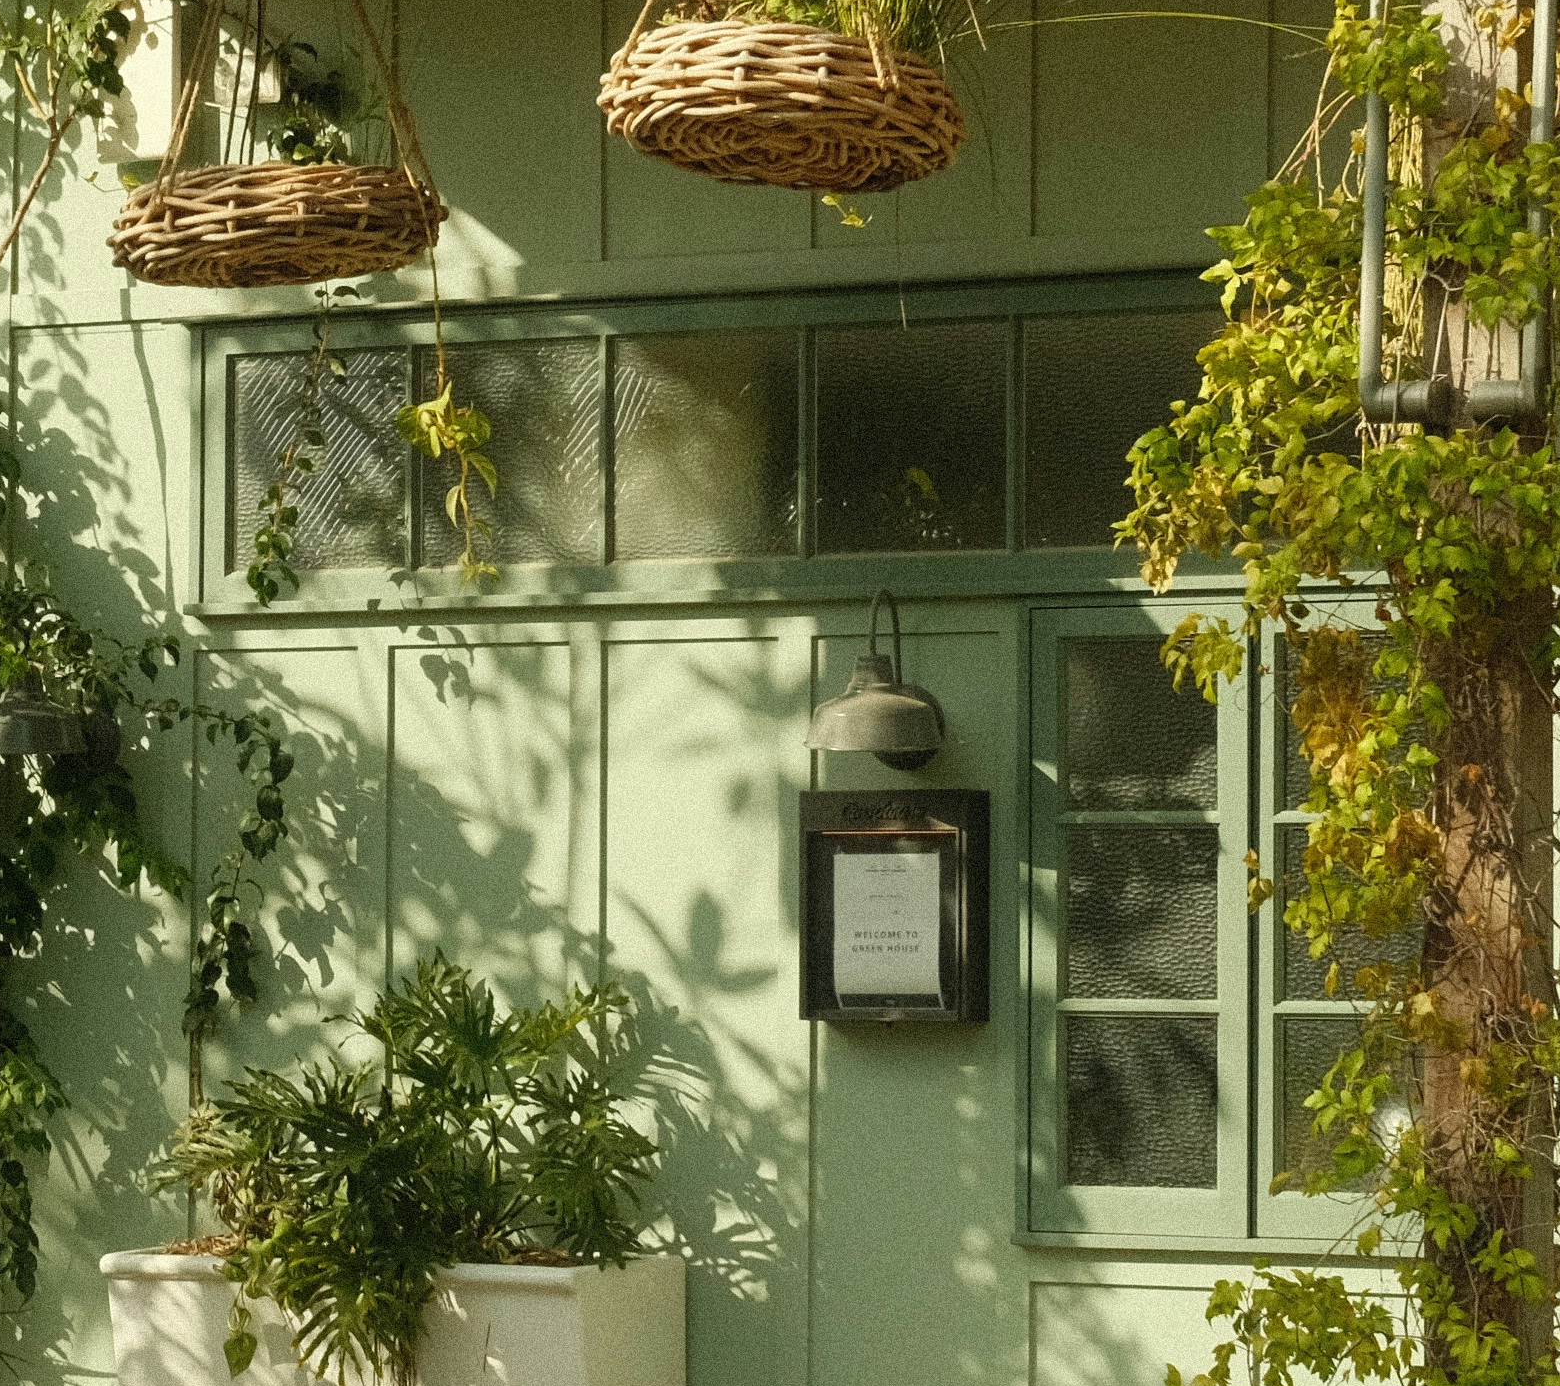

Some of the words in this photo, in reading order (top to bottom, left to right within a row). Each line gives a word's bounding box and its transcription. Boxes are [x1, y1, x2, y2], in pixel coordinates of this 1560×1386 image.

[854, 930, 903, 939] WELCOME
[905, 930, 919, 939] TO
[851, 944, 883, 953] GREEN
[887, 944, 920, 953] HOUSE
